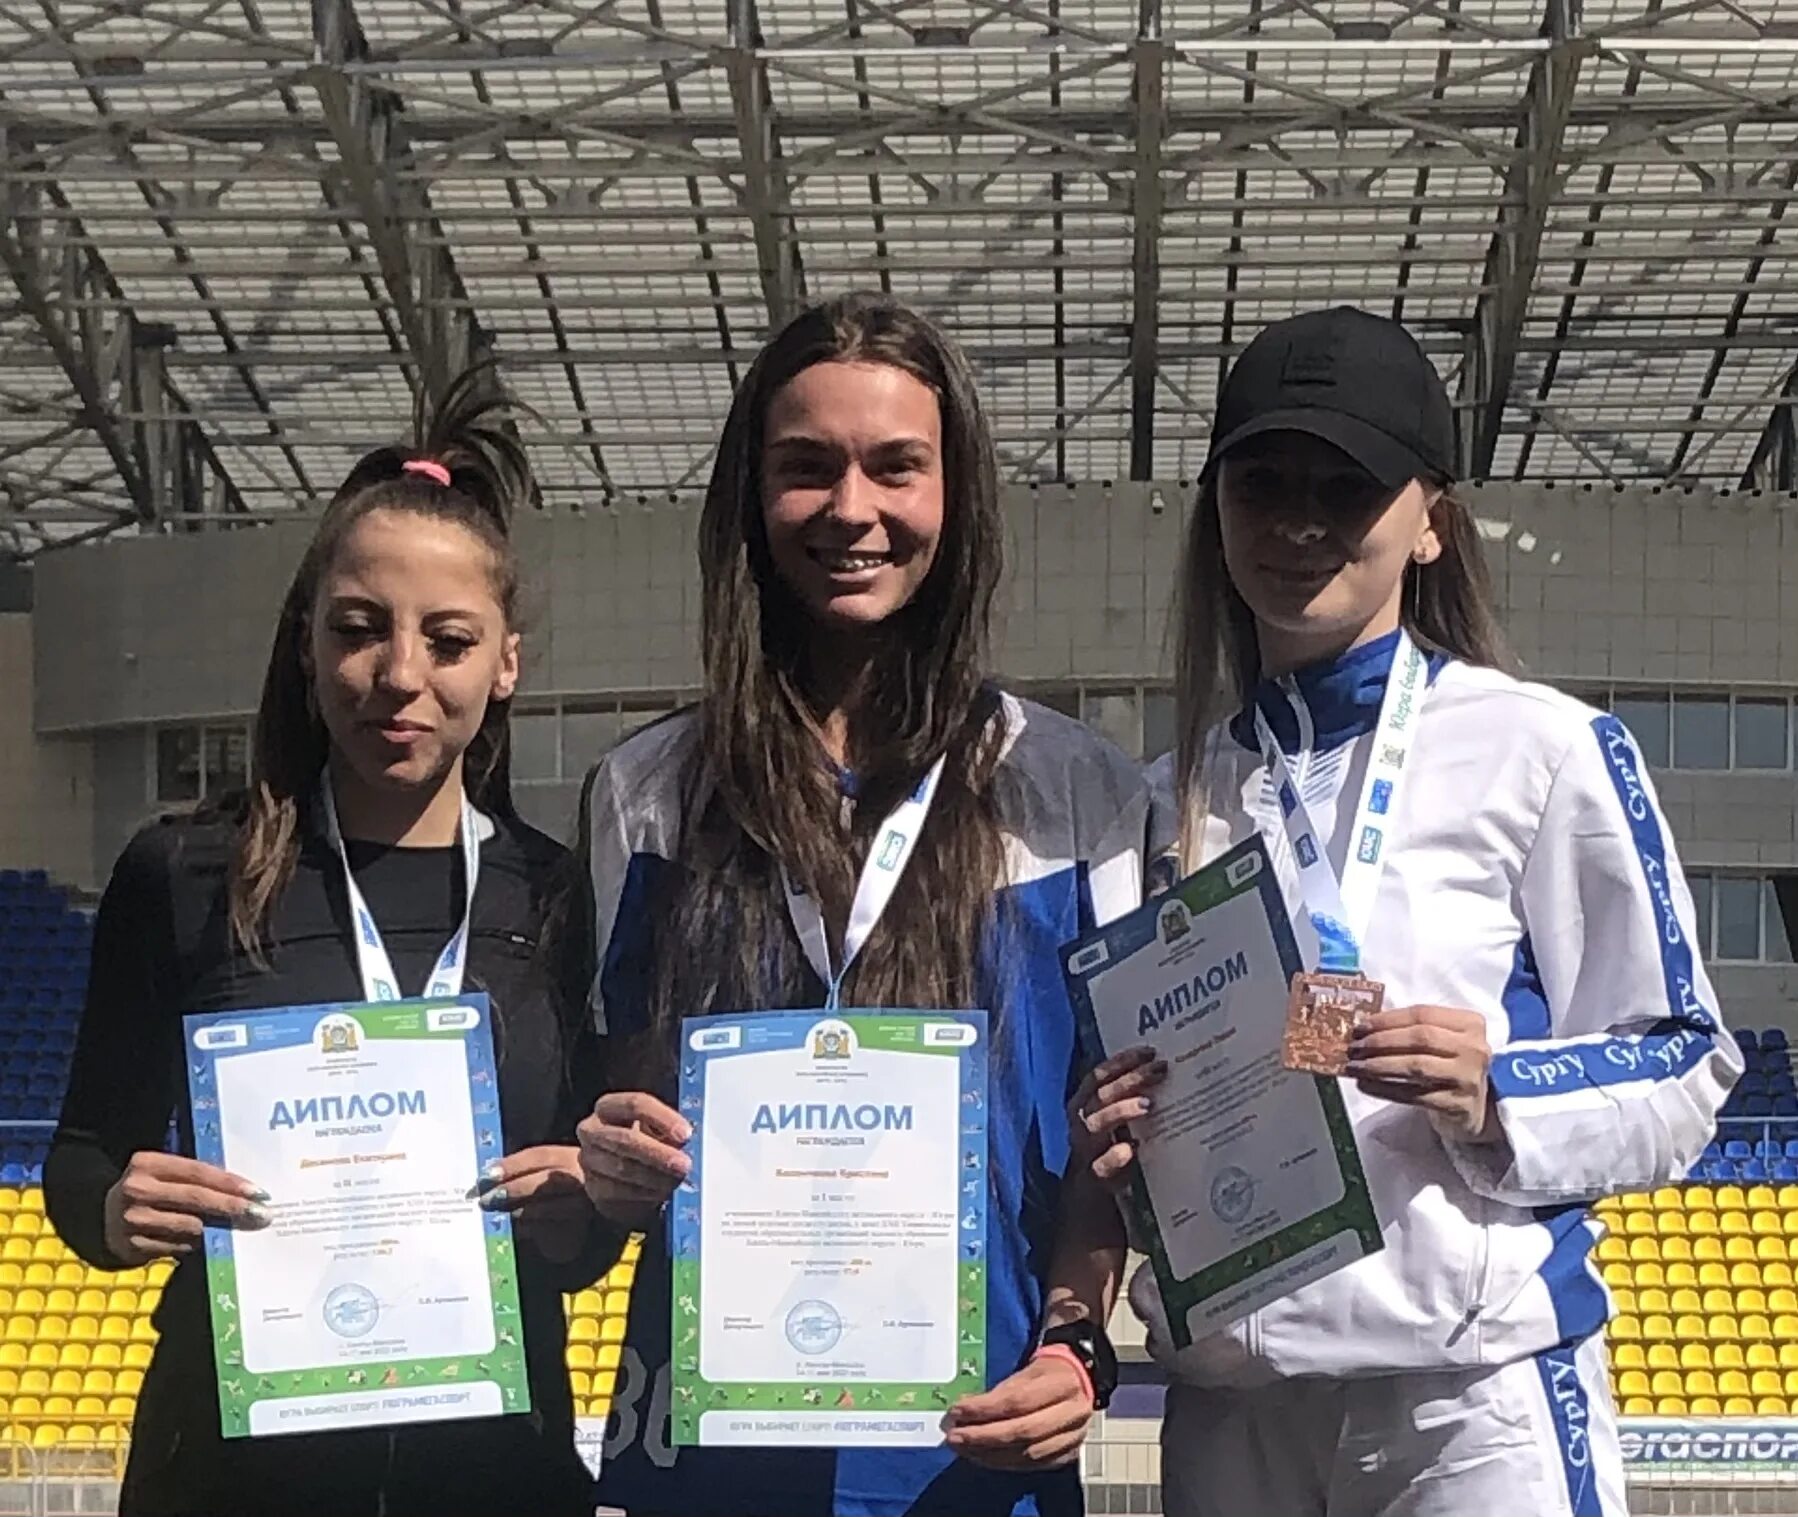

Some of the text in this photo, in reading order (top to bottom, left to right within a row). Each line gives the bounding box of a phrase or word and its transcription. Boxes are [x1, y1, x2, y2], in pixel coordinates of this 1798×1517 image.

[1137, 951, 1249, 1036] ДИПЛОМ
[269, 1090, 427, 1131] ДИПЛОМ
[751, 1104, 914, 1134] ДИПЛОМ
